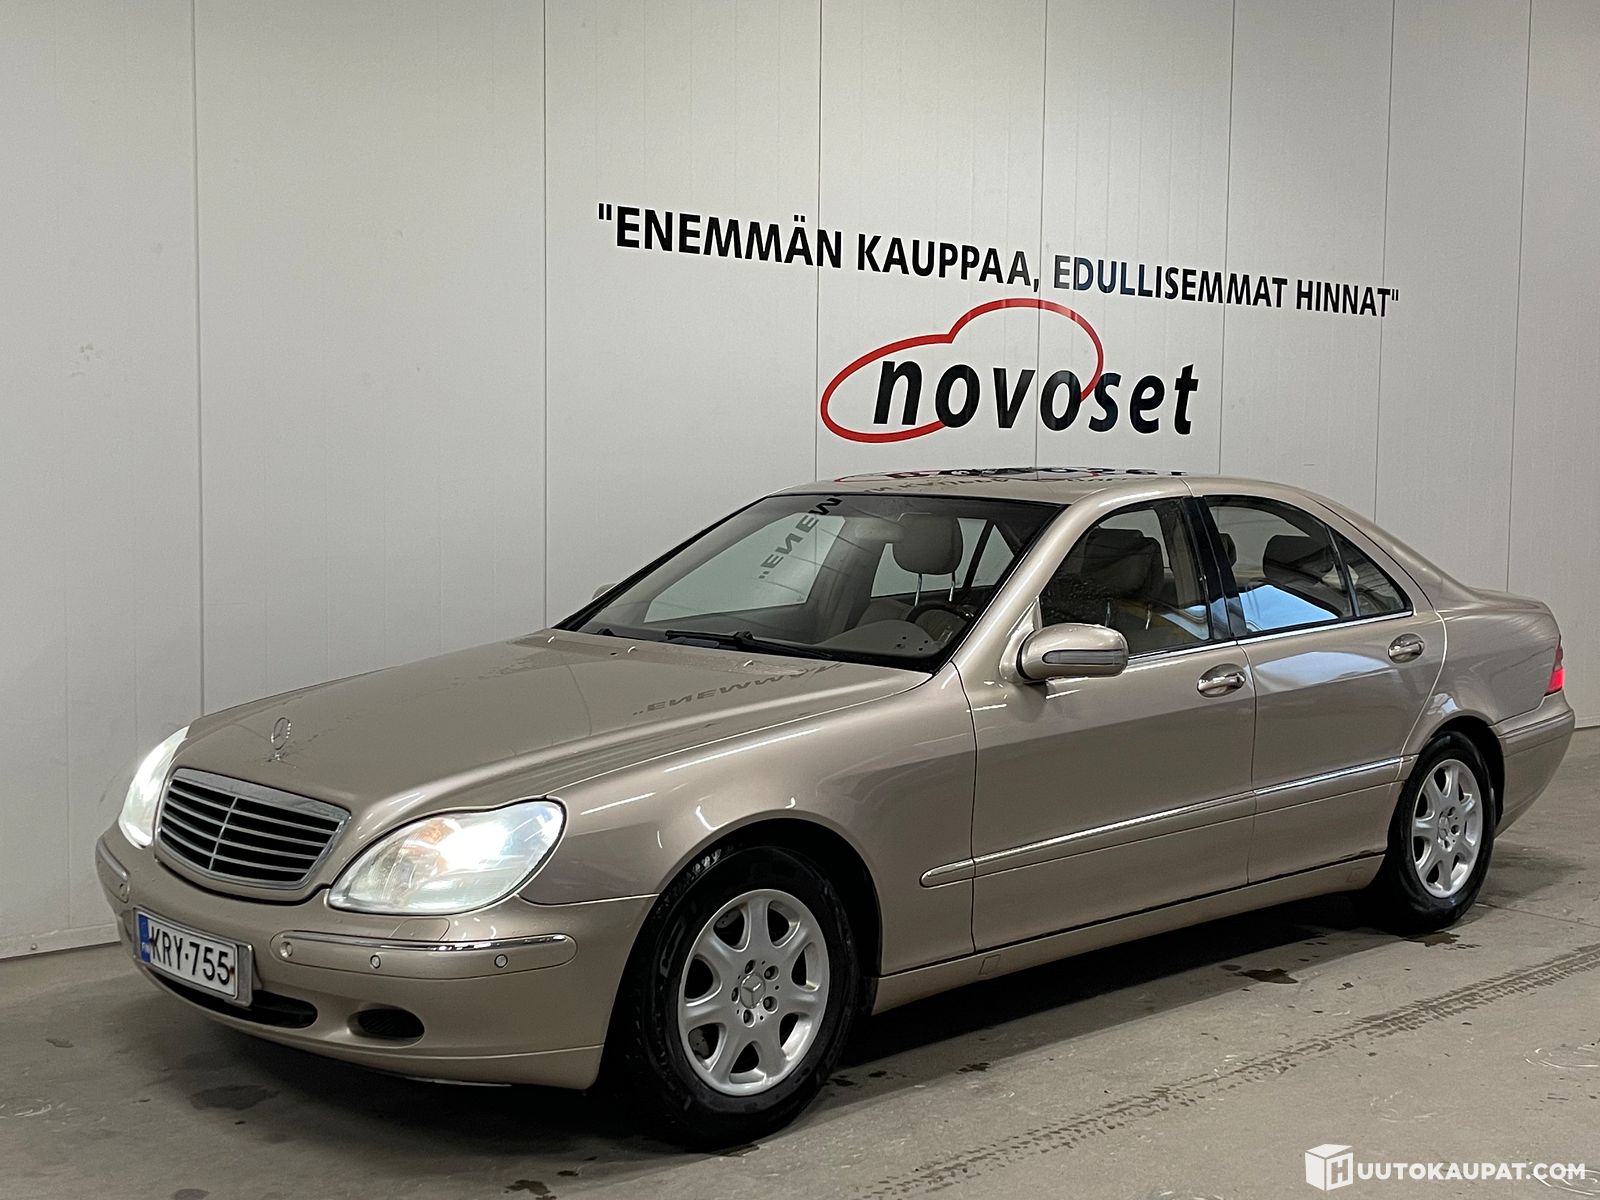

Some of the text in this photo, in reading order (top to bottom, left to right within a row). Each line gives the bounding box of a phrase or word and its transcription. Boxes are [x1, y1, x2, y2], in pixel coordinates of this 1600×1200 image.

[598, 202, 1399, 318] "ENEMMÄN KAUPPAA, EDULLISEMMAT HINNAT"
[873, 360, 1199, 435] novoset
[150, 926, 230, 986] KRY-755
